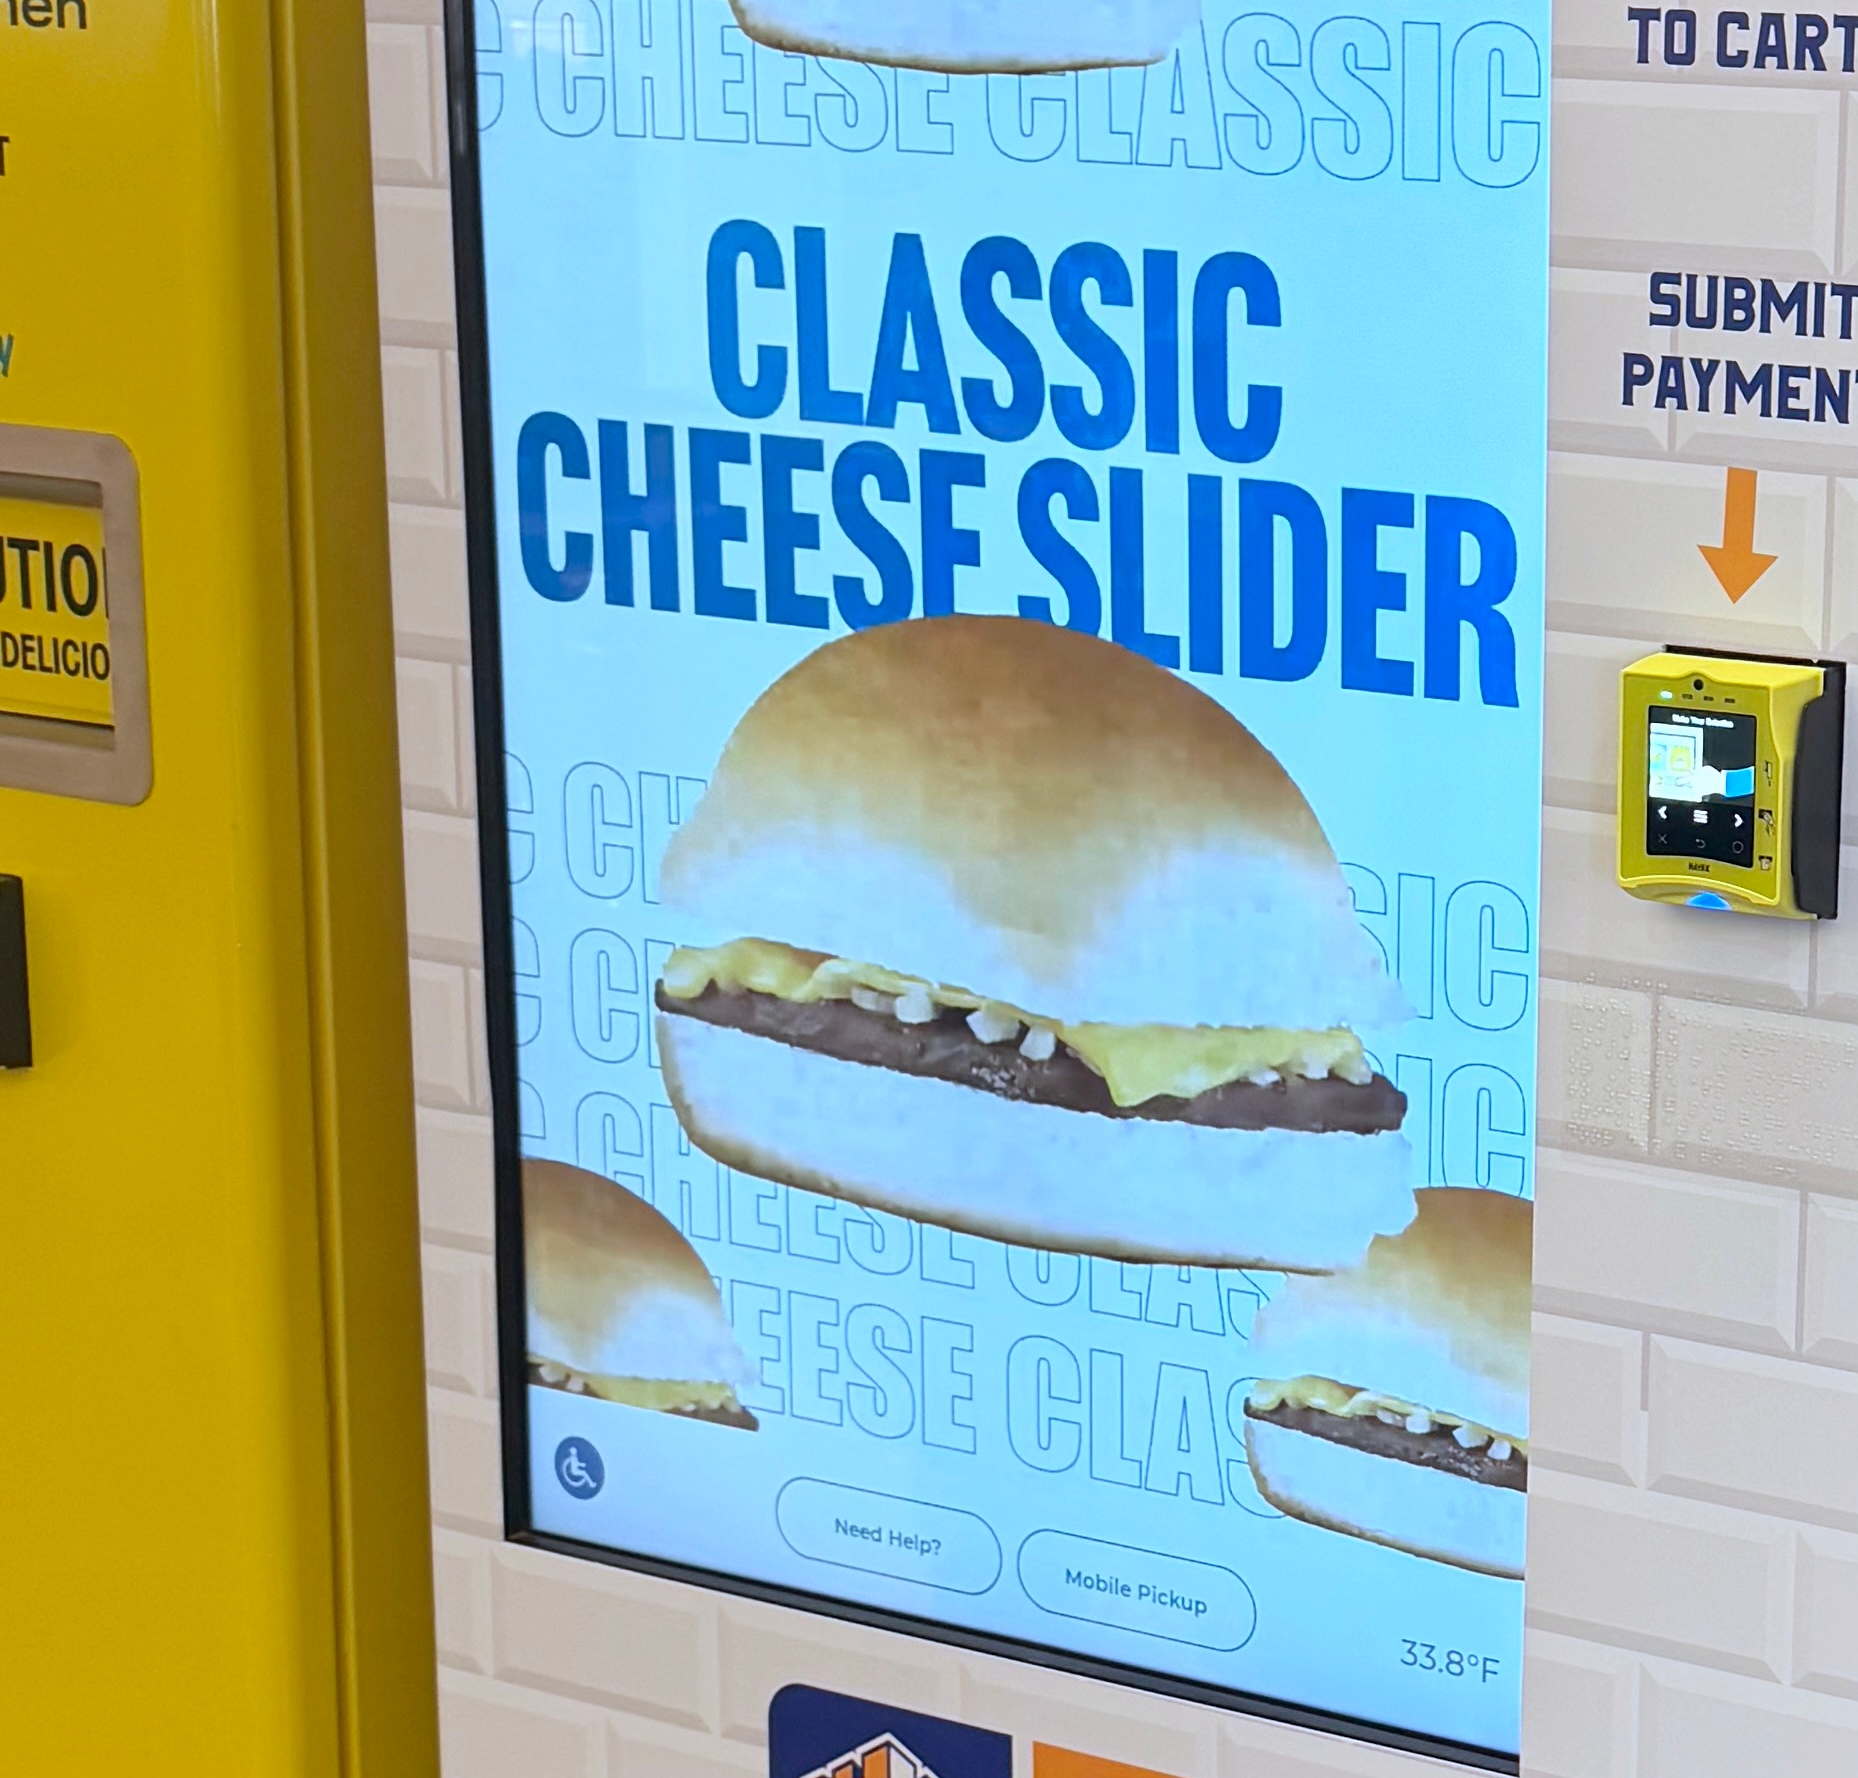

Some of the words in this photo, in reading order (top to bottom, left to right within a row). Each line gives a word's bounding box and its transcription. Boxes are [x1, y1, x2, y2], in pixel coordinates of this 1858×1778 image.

[1628, 6, 1696, 65] TO
[706, 219, 1283, 463] CLASSIC
[517, 411, 987, 633] CHEESE
[1017, 457, 1521, 709] SLIDER
[834, 1517, 882, 1542] Need
[889, 1530, 941, 1557] Help?
[1065, 1568, 1131, 1598] Mobile
[1138, 1585, 1208, 1617] Pickup
[1400, 1638, 1500, 1683] 33.8°F
